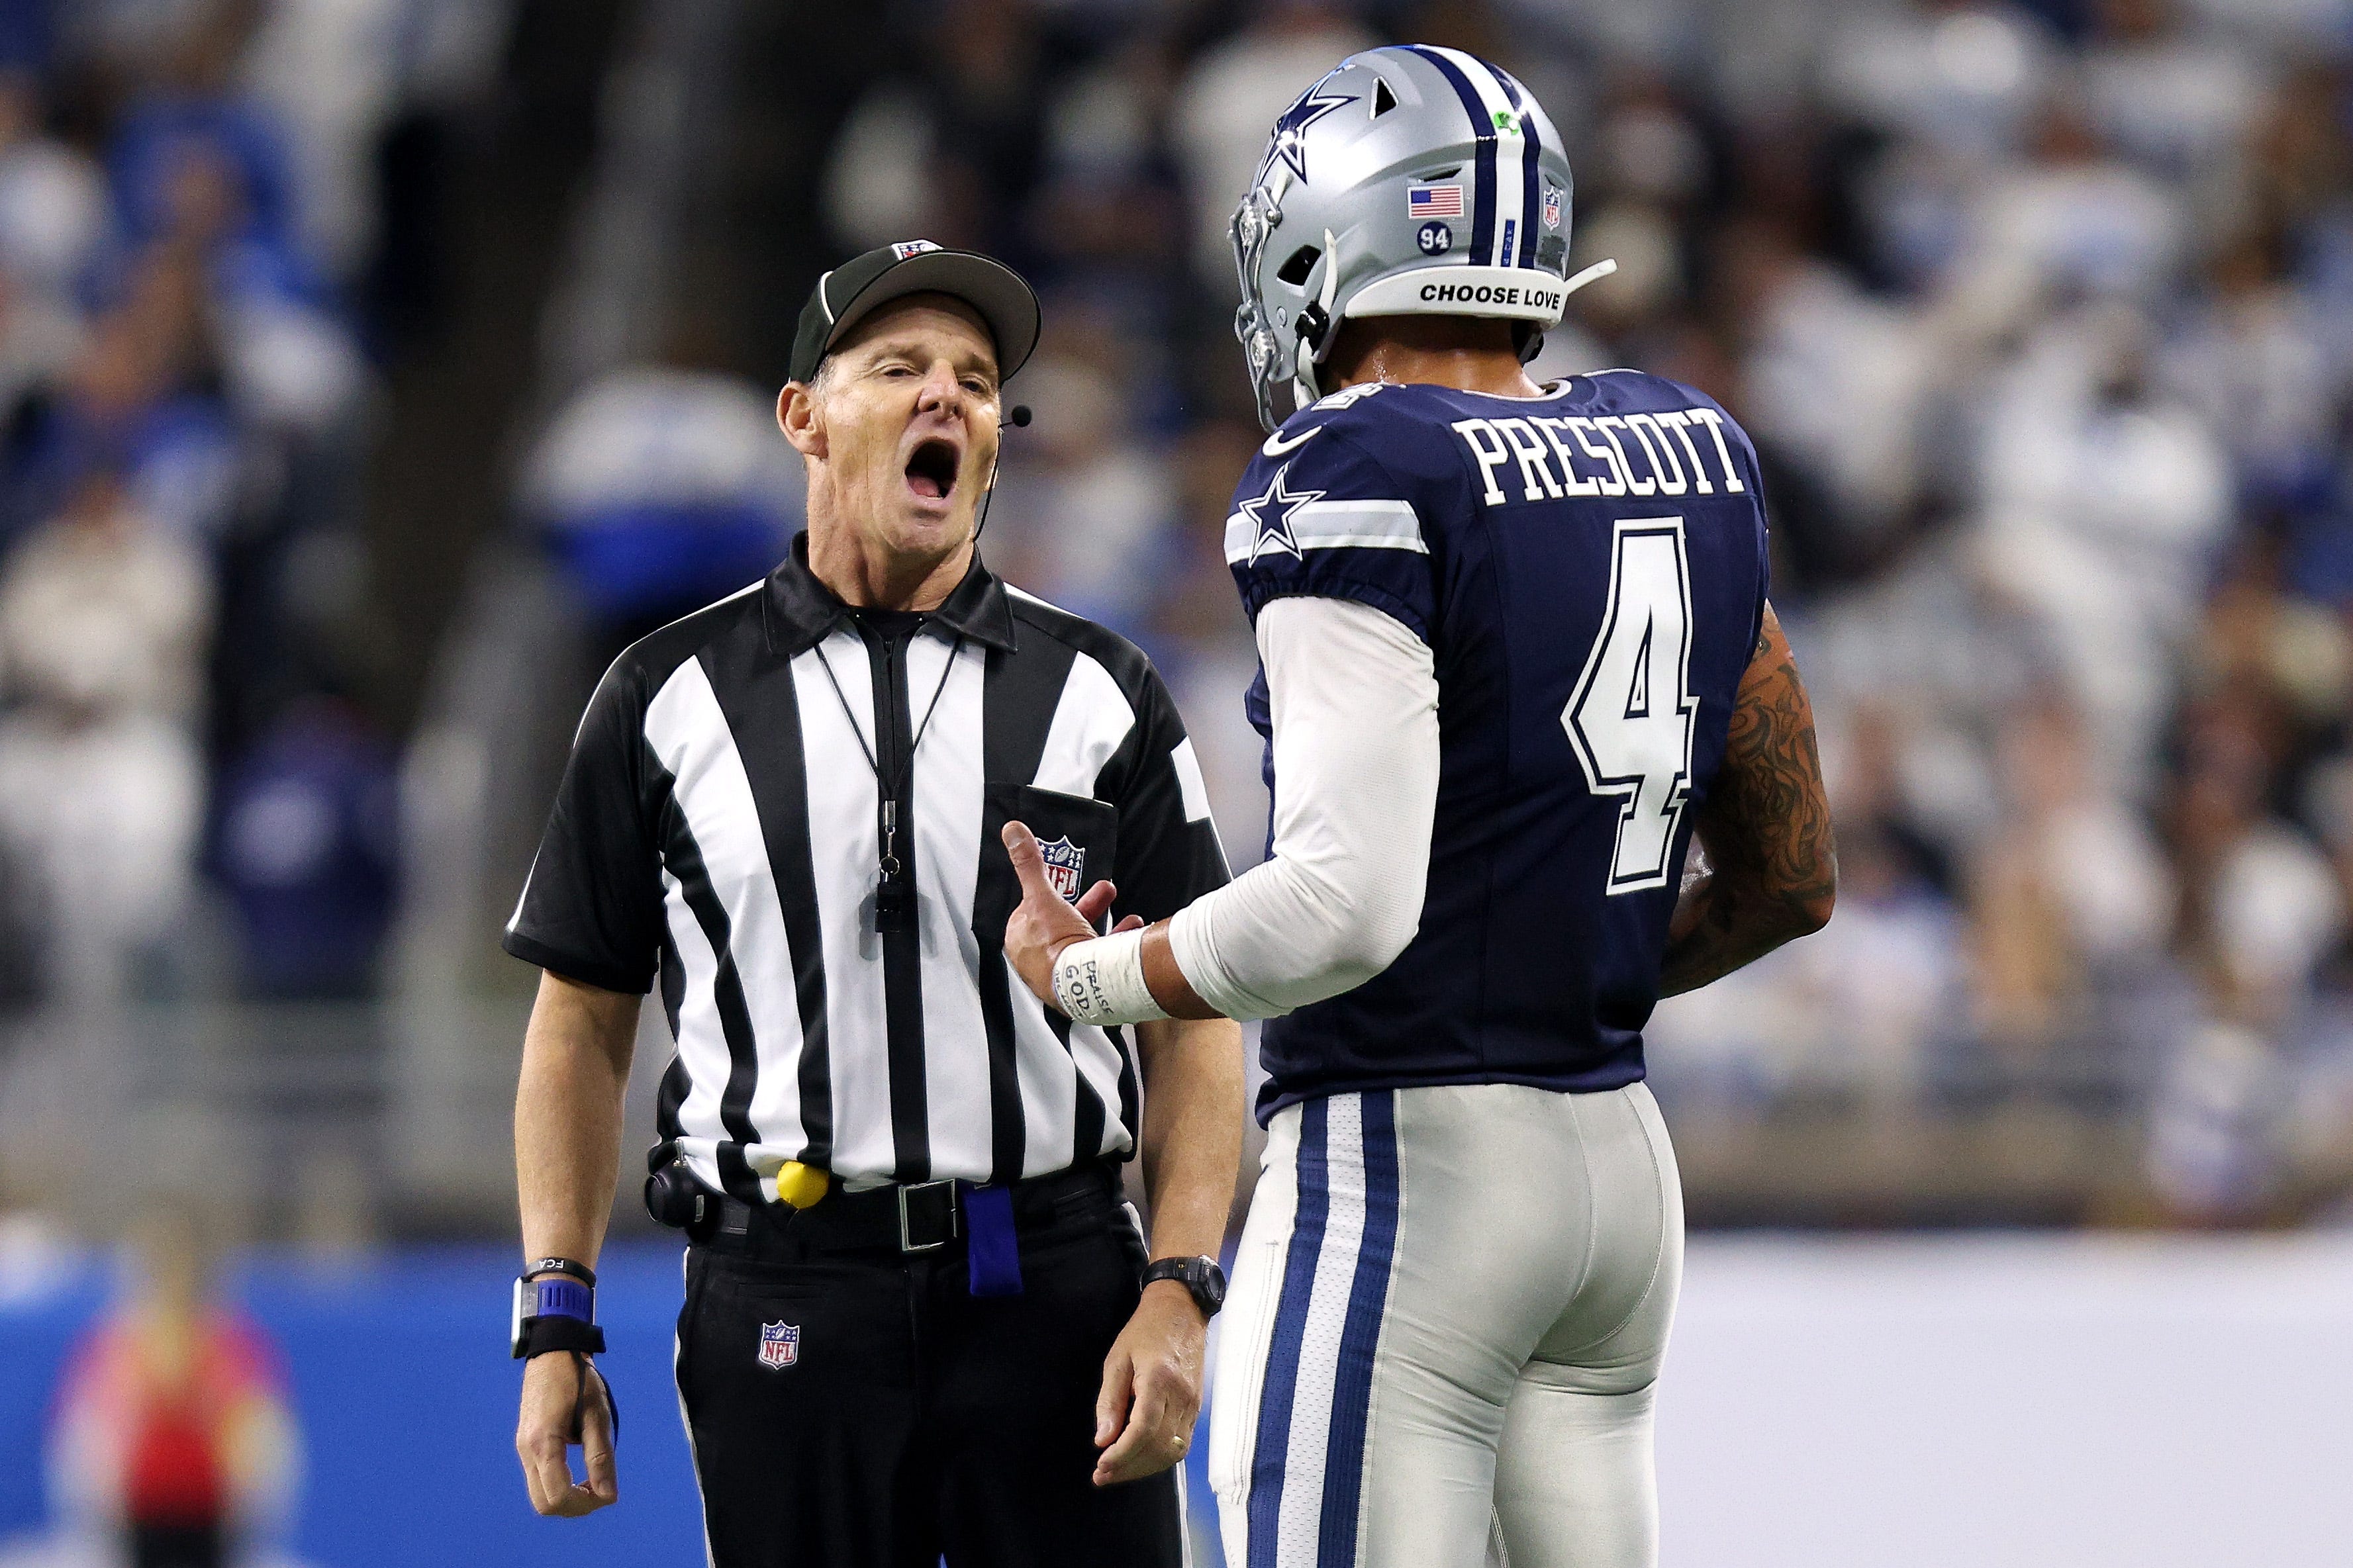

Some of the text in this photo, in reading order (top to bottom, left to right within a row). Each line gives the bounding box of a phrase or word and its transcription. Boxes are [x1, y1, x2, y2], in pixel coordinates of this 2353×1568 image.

[1419, 228, 1449, 250] 94
[1420, 283, 1561, 310] CHOOSE LOVE
[1451, 408, 1745, 506] PRESCOTT
[1561, 516, 1700, 896] 4
[1066, 964, 1090, 1010] GOD
[538, 1259, 565, 1269] FCA
[764, 1340, 794, 1361] NFL
